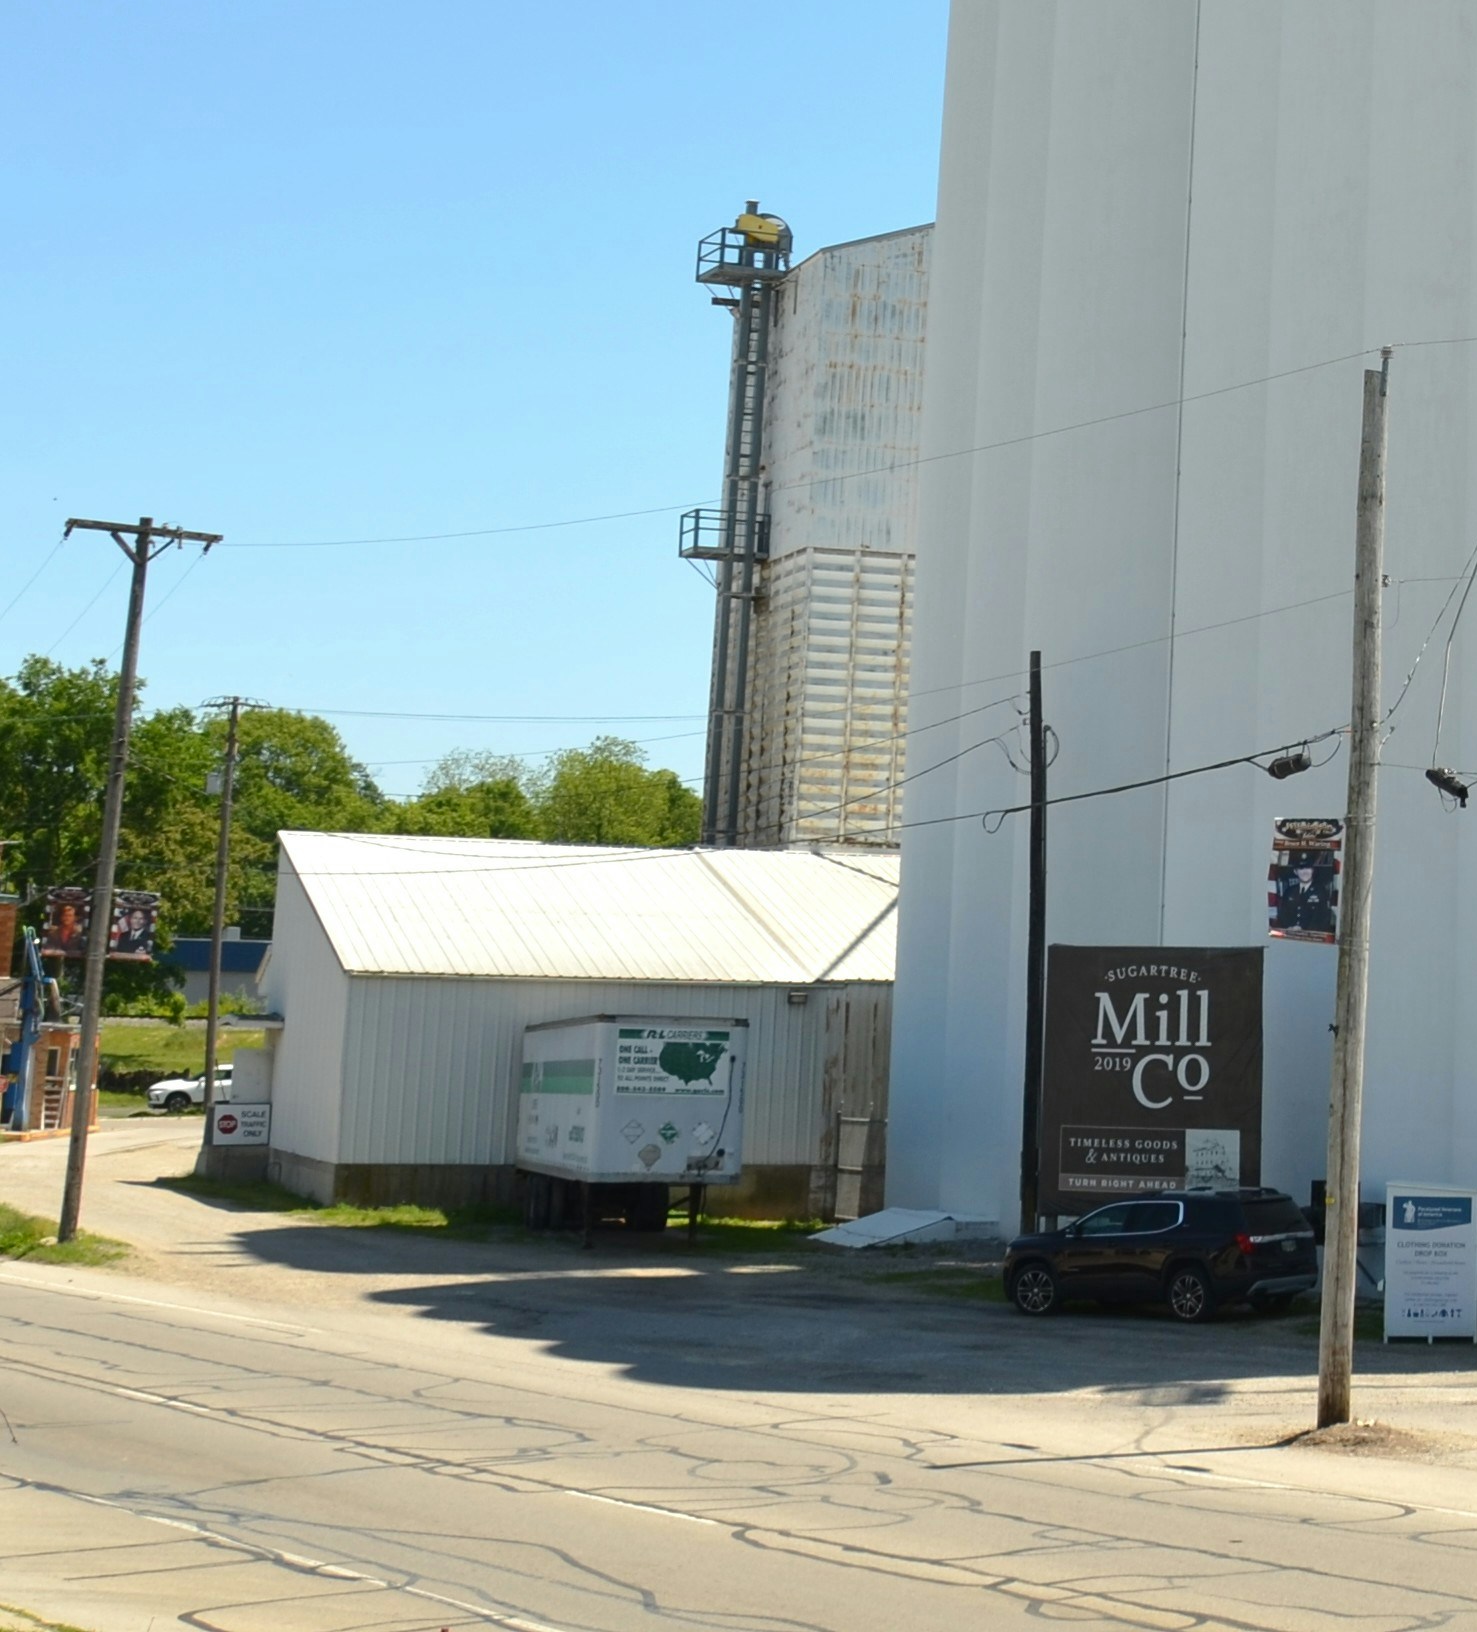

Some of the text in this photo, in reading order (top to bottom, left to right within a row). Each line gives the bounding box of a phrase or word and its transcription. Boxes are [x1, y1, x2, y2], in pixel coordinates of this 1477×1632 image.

[1107, 965, 1198, 983] SUGARTREE
[1091, 989, 1212, 1046] Mill
[667, 1030, 703, 1040] CARRIERS
[619, 1045, 648, 1054] ONE CALL
[618, 1056, 658, 1065] ONE CARRIER
[1094, 1053, 1210, 1109] 2019 Co
[1069, 1137, 1178, 1150] TIMELESS GOODS
[1085, 1148, 1165, 1164] & ANTIQUES
[1068, 1178, 1176, 1190] TURN RIGHT AHEAD
